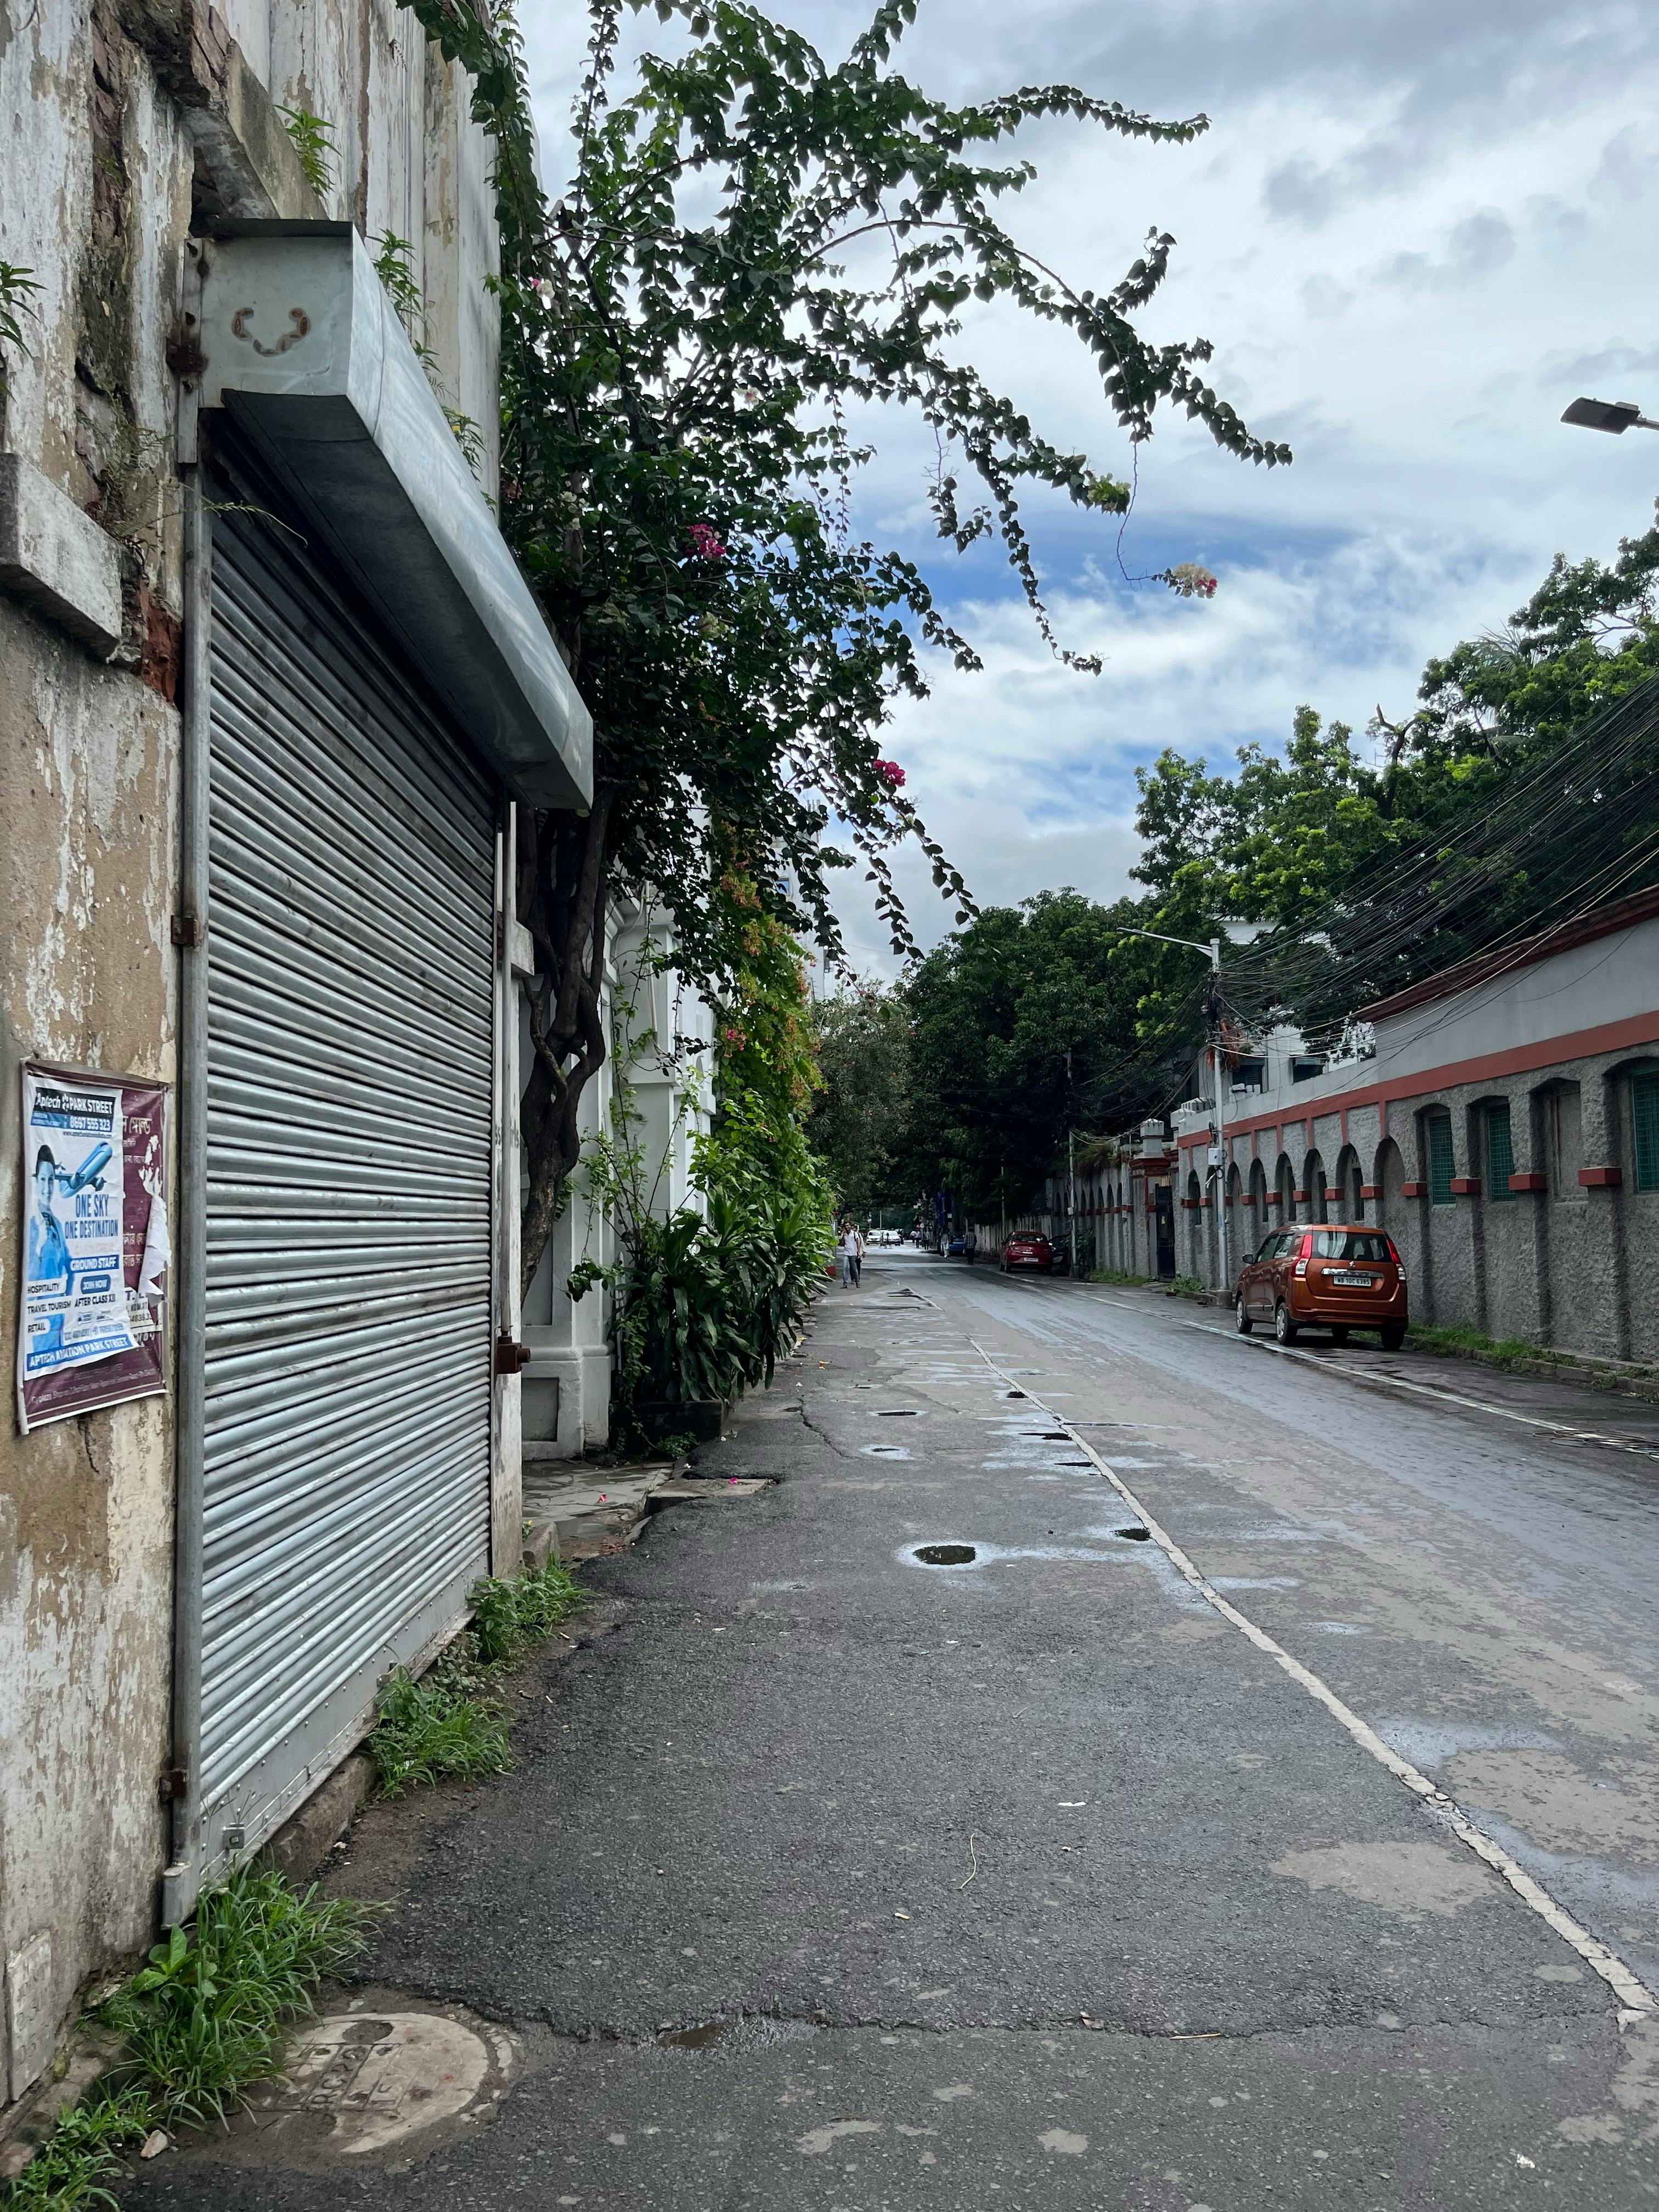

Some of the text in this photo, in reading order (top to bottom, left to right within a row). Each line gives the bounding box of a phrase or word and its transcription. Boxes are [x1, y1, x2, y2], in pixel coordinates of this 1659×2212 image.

[36, 1092, 112, 1114] Aptech PARK STREET
[76, 1194, 109, 1217] ONE SKY
[65, 1220, 118, 1239] ONE DESTINATION
[70, 1258, 98, 1271] GROUND
[98, 1256, 116, 1268] STAFF
[27, 1283, 60, 1294] HOSPITALITY
[83, 1279, 108, 1290] JOIN NOW
[27, 1301, 71, 1314] TRAVEL TOURISM
[74, 1297, 91, 1307] AFTER
[92, 1295, 108, 1304] CLASS
[27, 1322, 46, 1333] RETAIL
[30, 1352, 54, 1367] APTECH
[56, 1345, 84, 1361] AVIATION
[86, 1341, 106, 1353] PARK
[105, 1336, 128, 1350] STREET
